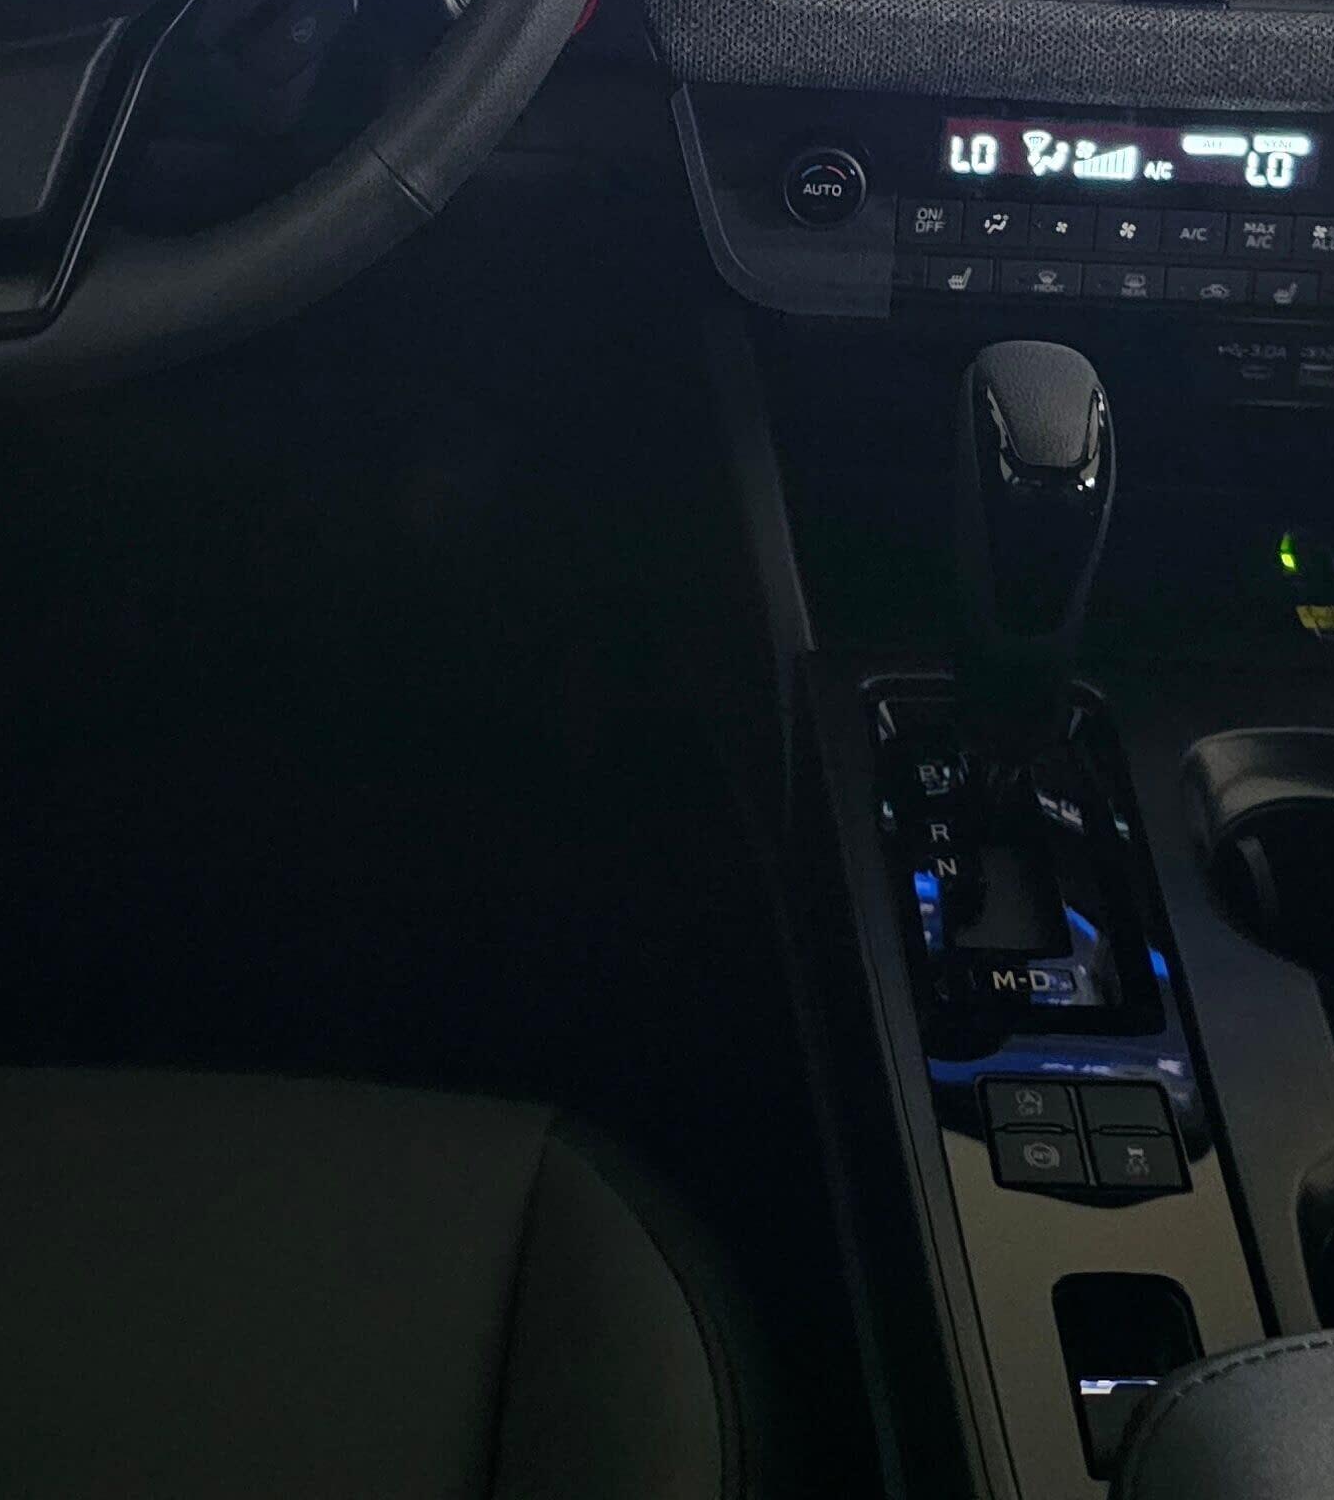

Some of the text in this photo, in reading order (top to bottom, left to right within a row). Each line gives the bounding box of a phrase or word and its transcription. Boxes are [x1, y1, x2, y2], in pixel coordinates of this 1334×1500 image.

[1143, 160, 1174, 181] A/C
[802, 183, 843, 198] AUTO
[917, 206, 944, 220] ON/
[914, 220, 945, 234] OFF
[1179, 226, 1208, 242] A/C
[1245, 235, 1274, 250] A/C
[930, 824, 949, 842] R
[936, 858, 959, 876] N
